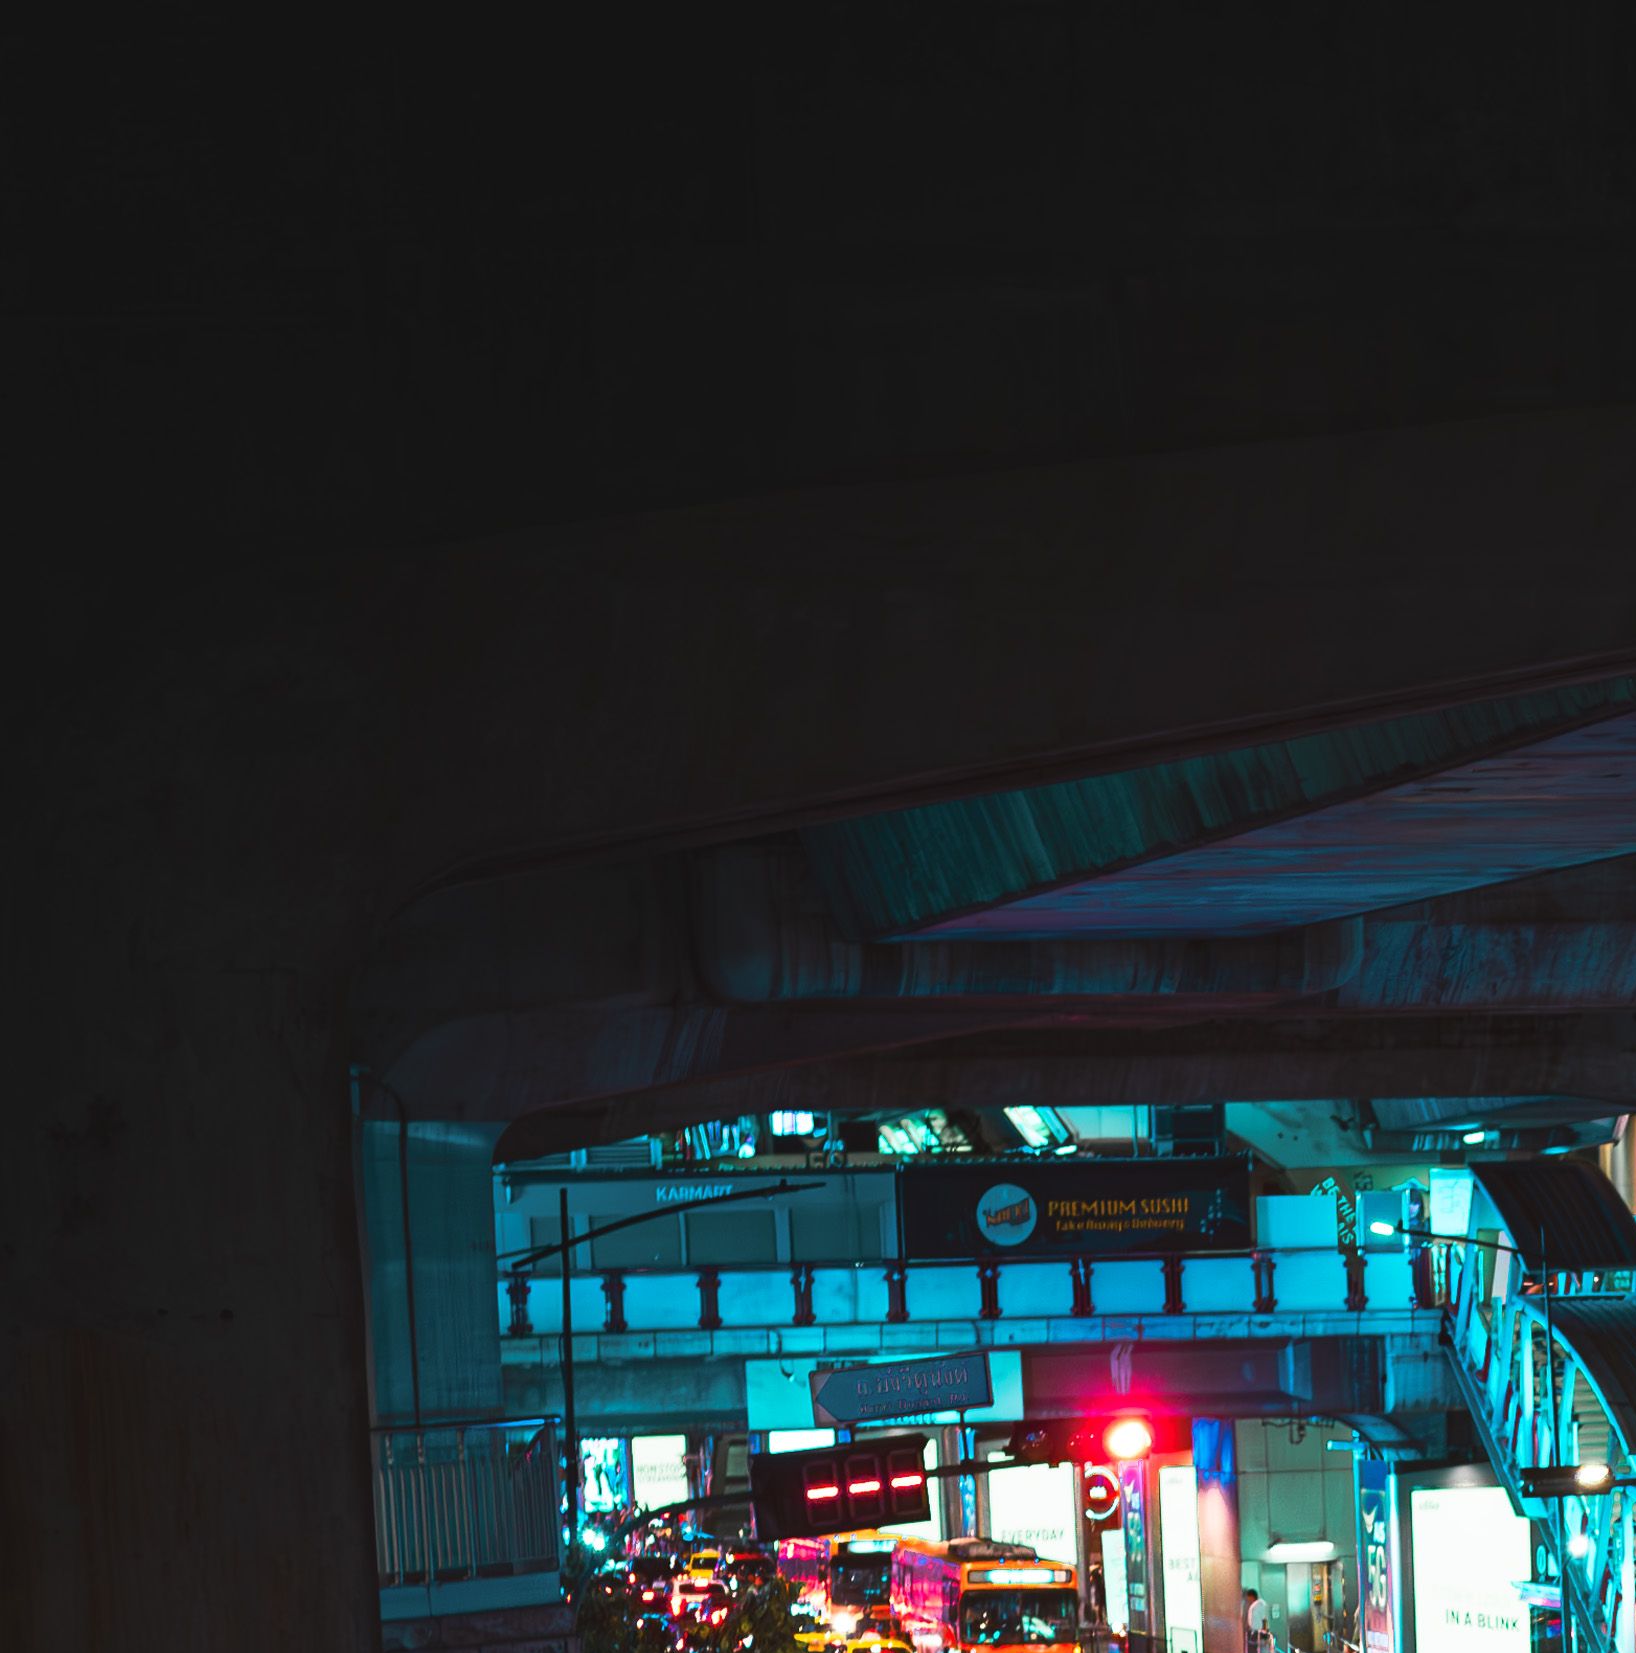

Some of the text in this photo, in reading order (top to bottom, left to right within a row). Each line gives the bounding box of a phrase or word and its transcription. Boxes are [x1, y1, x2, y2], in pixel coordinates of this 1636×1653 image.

[1048, 1198, 1137, 1217] PREMIUM
[1139, 1197, 1189, 1214] SUSHI
[1000, 1528, 1065, 1546] EVERYDAY
[1445, 1609, 1521, 1632] IN A BLINK
